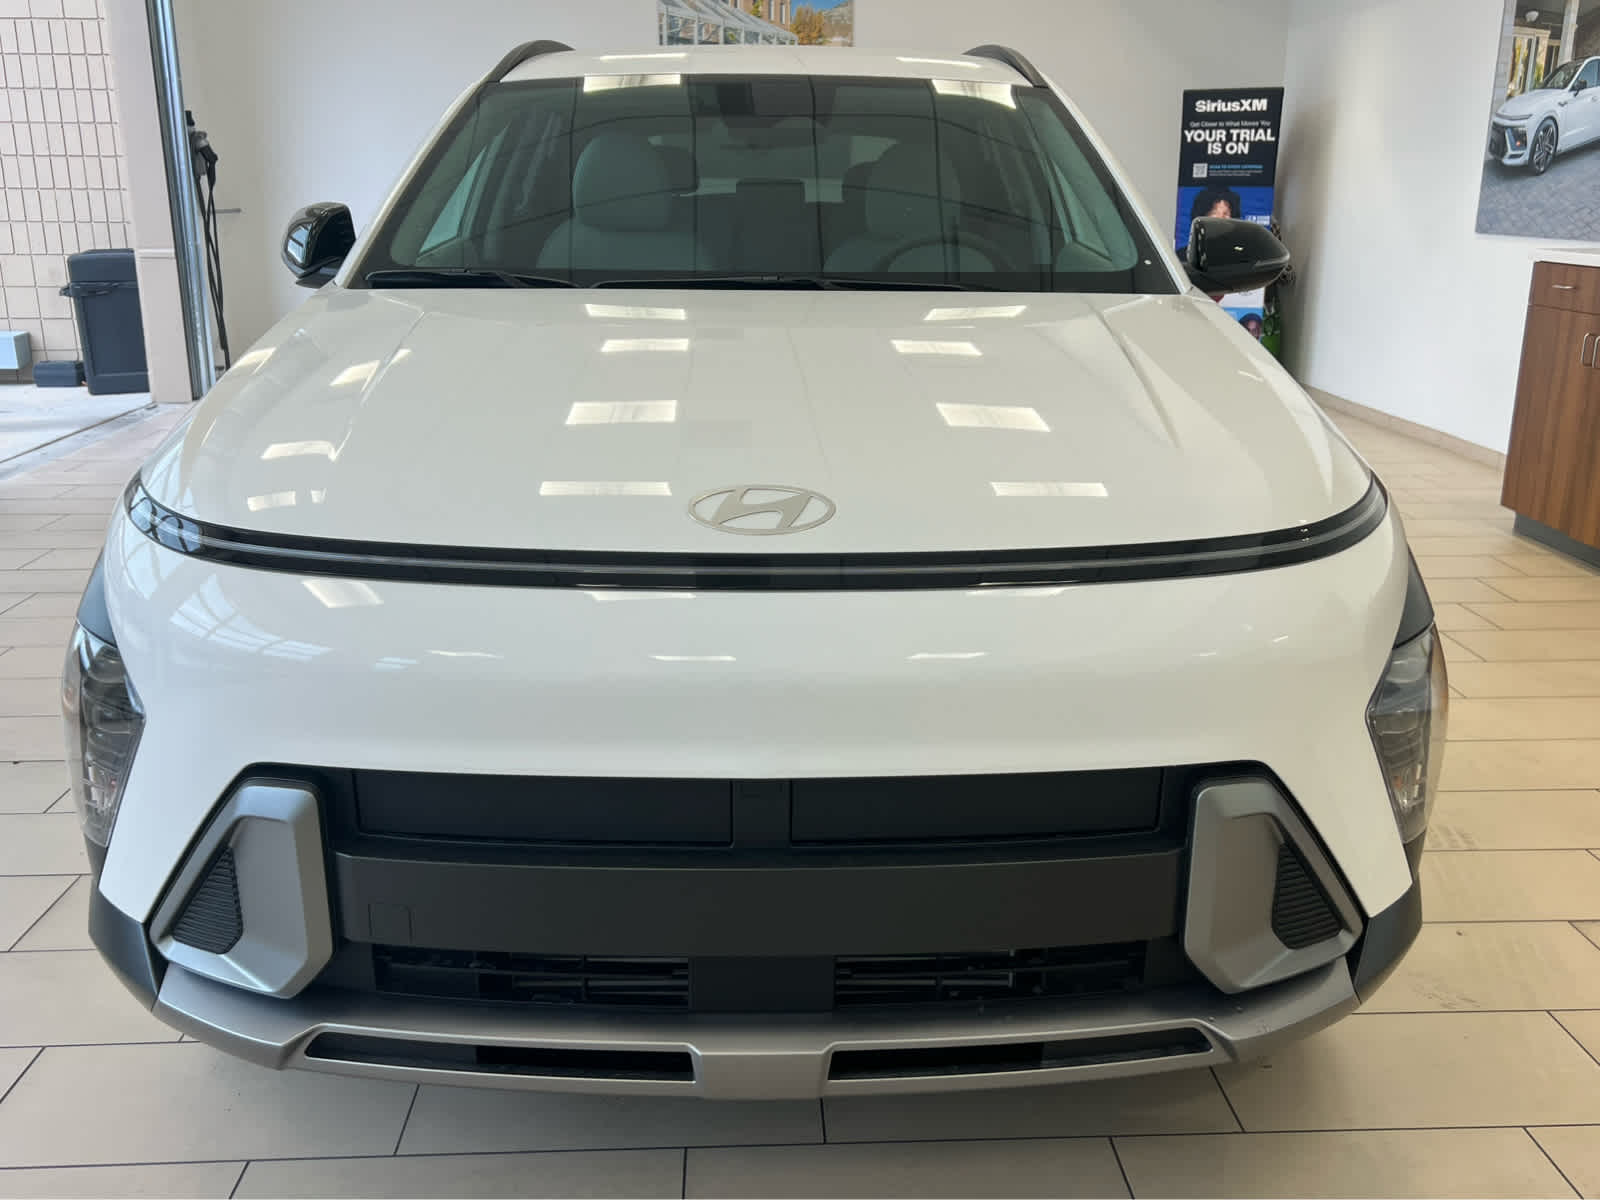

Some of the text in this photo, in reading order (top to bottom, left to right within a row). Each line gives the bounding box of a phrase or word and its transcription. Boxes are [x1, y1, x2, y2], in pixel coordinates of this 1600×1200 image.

[1195, 98, 1268, 113] SiriusXM
[1184, 128, 1275, 143] YOUR TRIAL
[1207, 142, 1249, 155] IS ON
